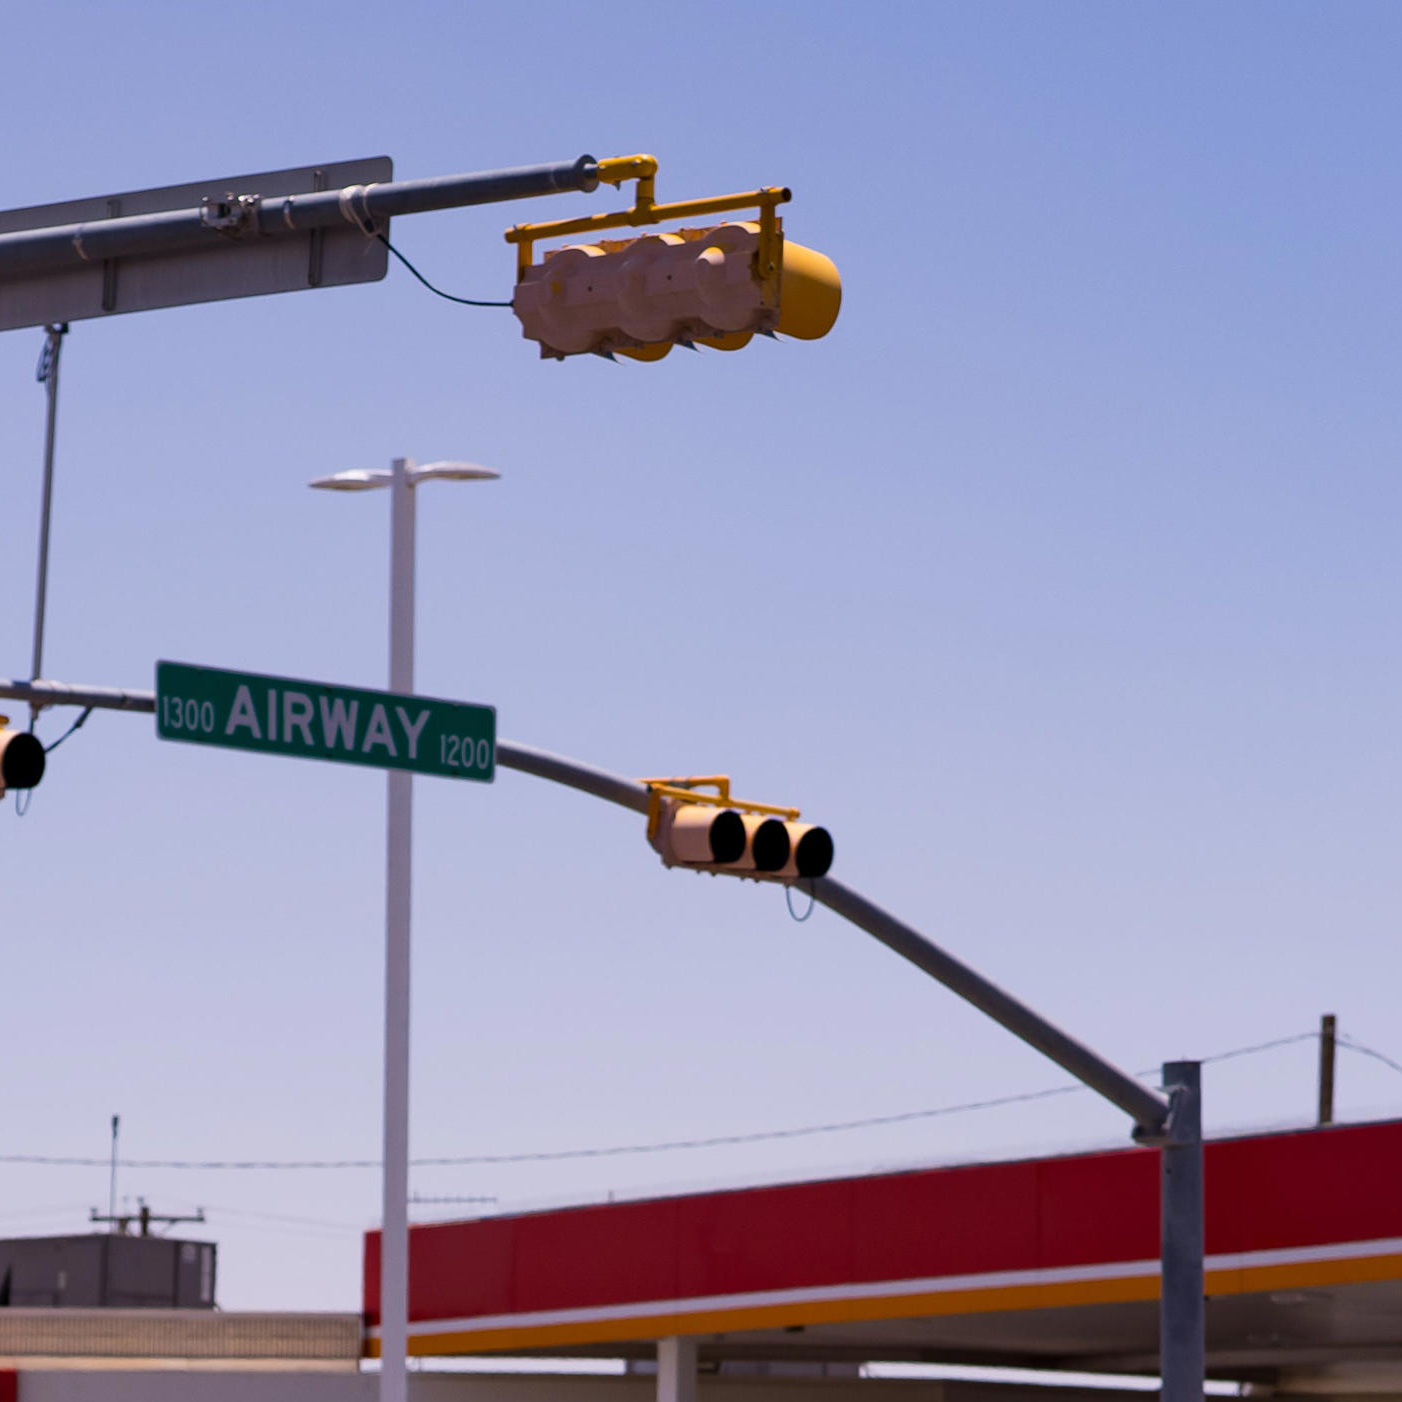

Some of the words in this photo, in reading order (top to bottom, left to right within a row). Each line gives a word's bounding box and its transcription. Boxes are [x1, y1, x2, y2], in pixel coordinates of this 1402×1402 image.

[163, 696, 214, 733] 1300
[225, 685, 431, 759] AIRWAY
[440, 734, 490, 769] 1200
